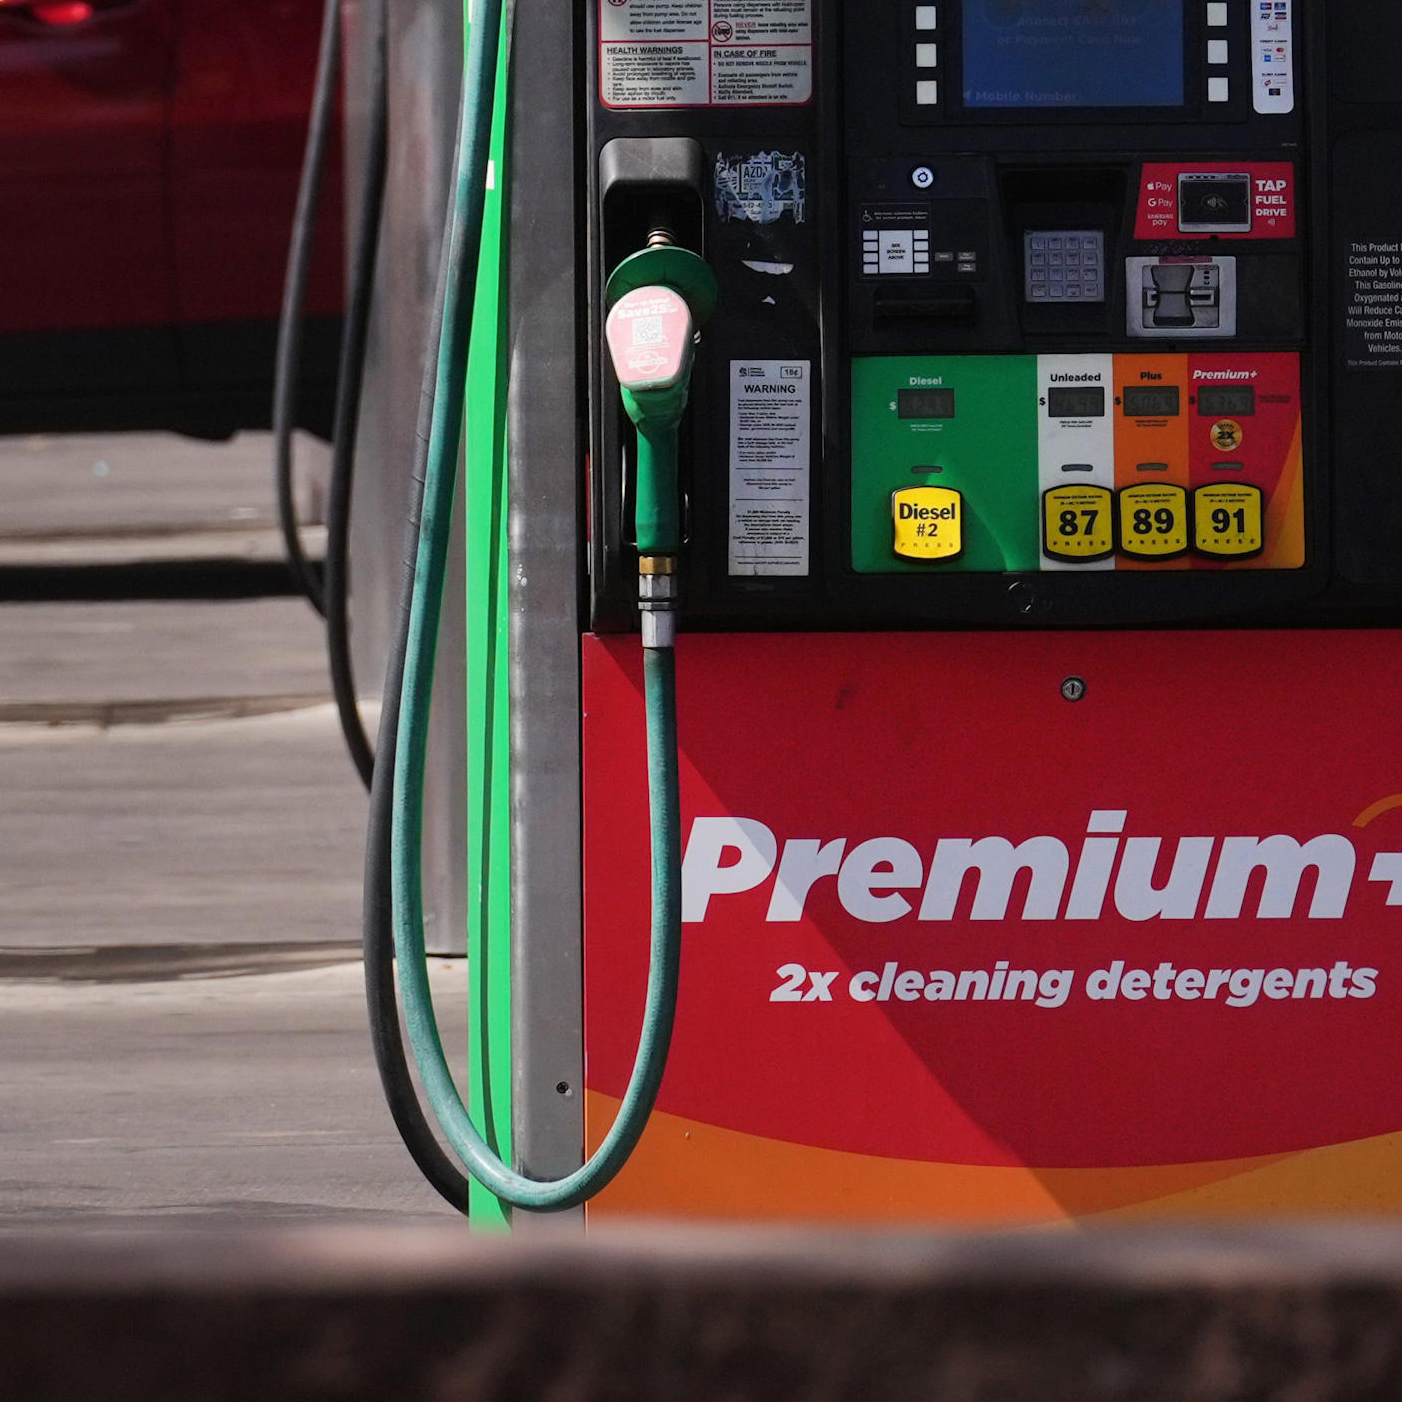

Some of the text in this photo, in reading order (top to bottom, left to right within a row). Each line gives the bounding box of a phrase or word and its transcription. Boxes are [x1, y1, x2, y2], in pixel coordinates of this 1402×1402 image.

[640, 46, 683, 54] WARNINGS
[1156, 182, 1172, 192] Pay
[1255, 180, 1287, 192] TAP
[1147, 198, 1173, 208] G Pay
[1255, 195, 1286, 205] FUEL
[1256, 208, 1287, 217] DRIVE
[1351, 243, 1367, 251] This
[1369, 243, 1398, 252] Product
[1349, 256, 1378, 264] Contain
[1380, 256, 1390, 266] Up
[1392, 256, 1400, 264] to
[1349, 269, 1377, 277] Ethanol
[1379, 269, 1388, 278] by
[1355, 281, 1371, 289] This
[1354, 293, 1399, 303] Oxygenated
[1348, 306, 1362, 315] Will
[1364, 306, 1392, 314] Reduce
[1347, 319, 1383, 327] Monoxide
[1364, 331, 1381, 339] from
[1368, 344, 1402, 352] Vehicles.
[1050, 373, 1101, 383] Unleaded
[1140, 371, 1162, 381] Plus
[1192, 369, 1258, 380] Premium+
[909, 375, 942, 387] Diesel
[744, 385, 796, 394] WARNING
[889, 400, 897, 412] $
[1039, 396, 1046, 407] $
[1217, 430, 1235, 440] 2X
[899, 503, 955, 520] Diesel
[1058, 510, 1099, 536] 87
[1133, 509, 1175, 534] 89
[1211, 507, 1246, 533] 91
[916, 524, 938, 537] #2
[769, 959, 1378, 1009] 2x cleaning detergents
